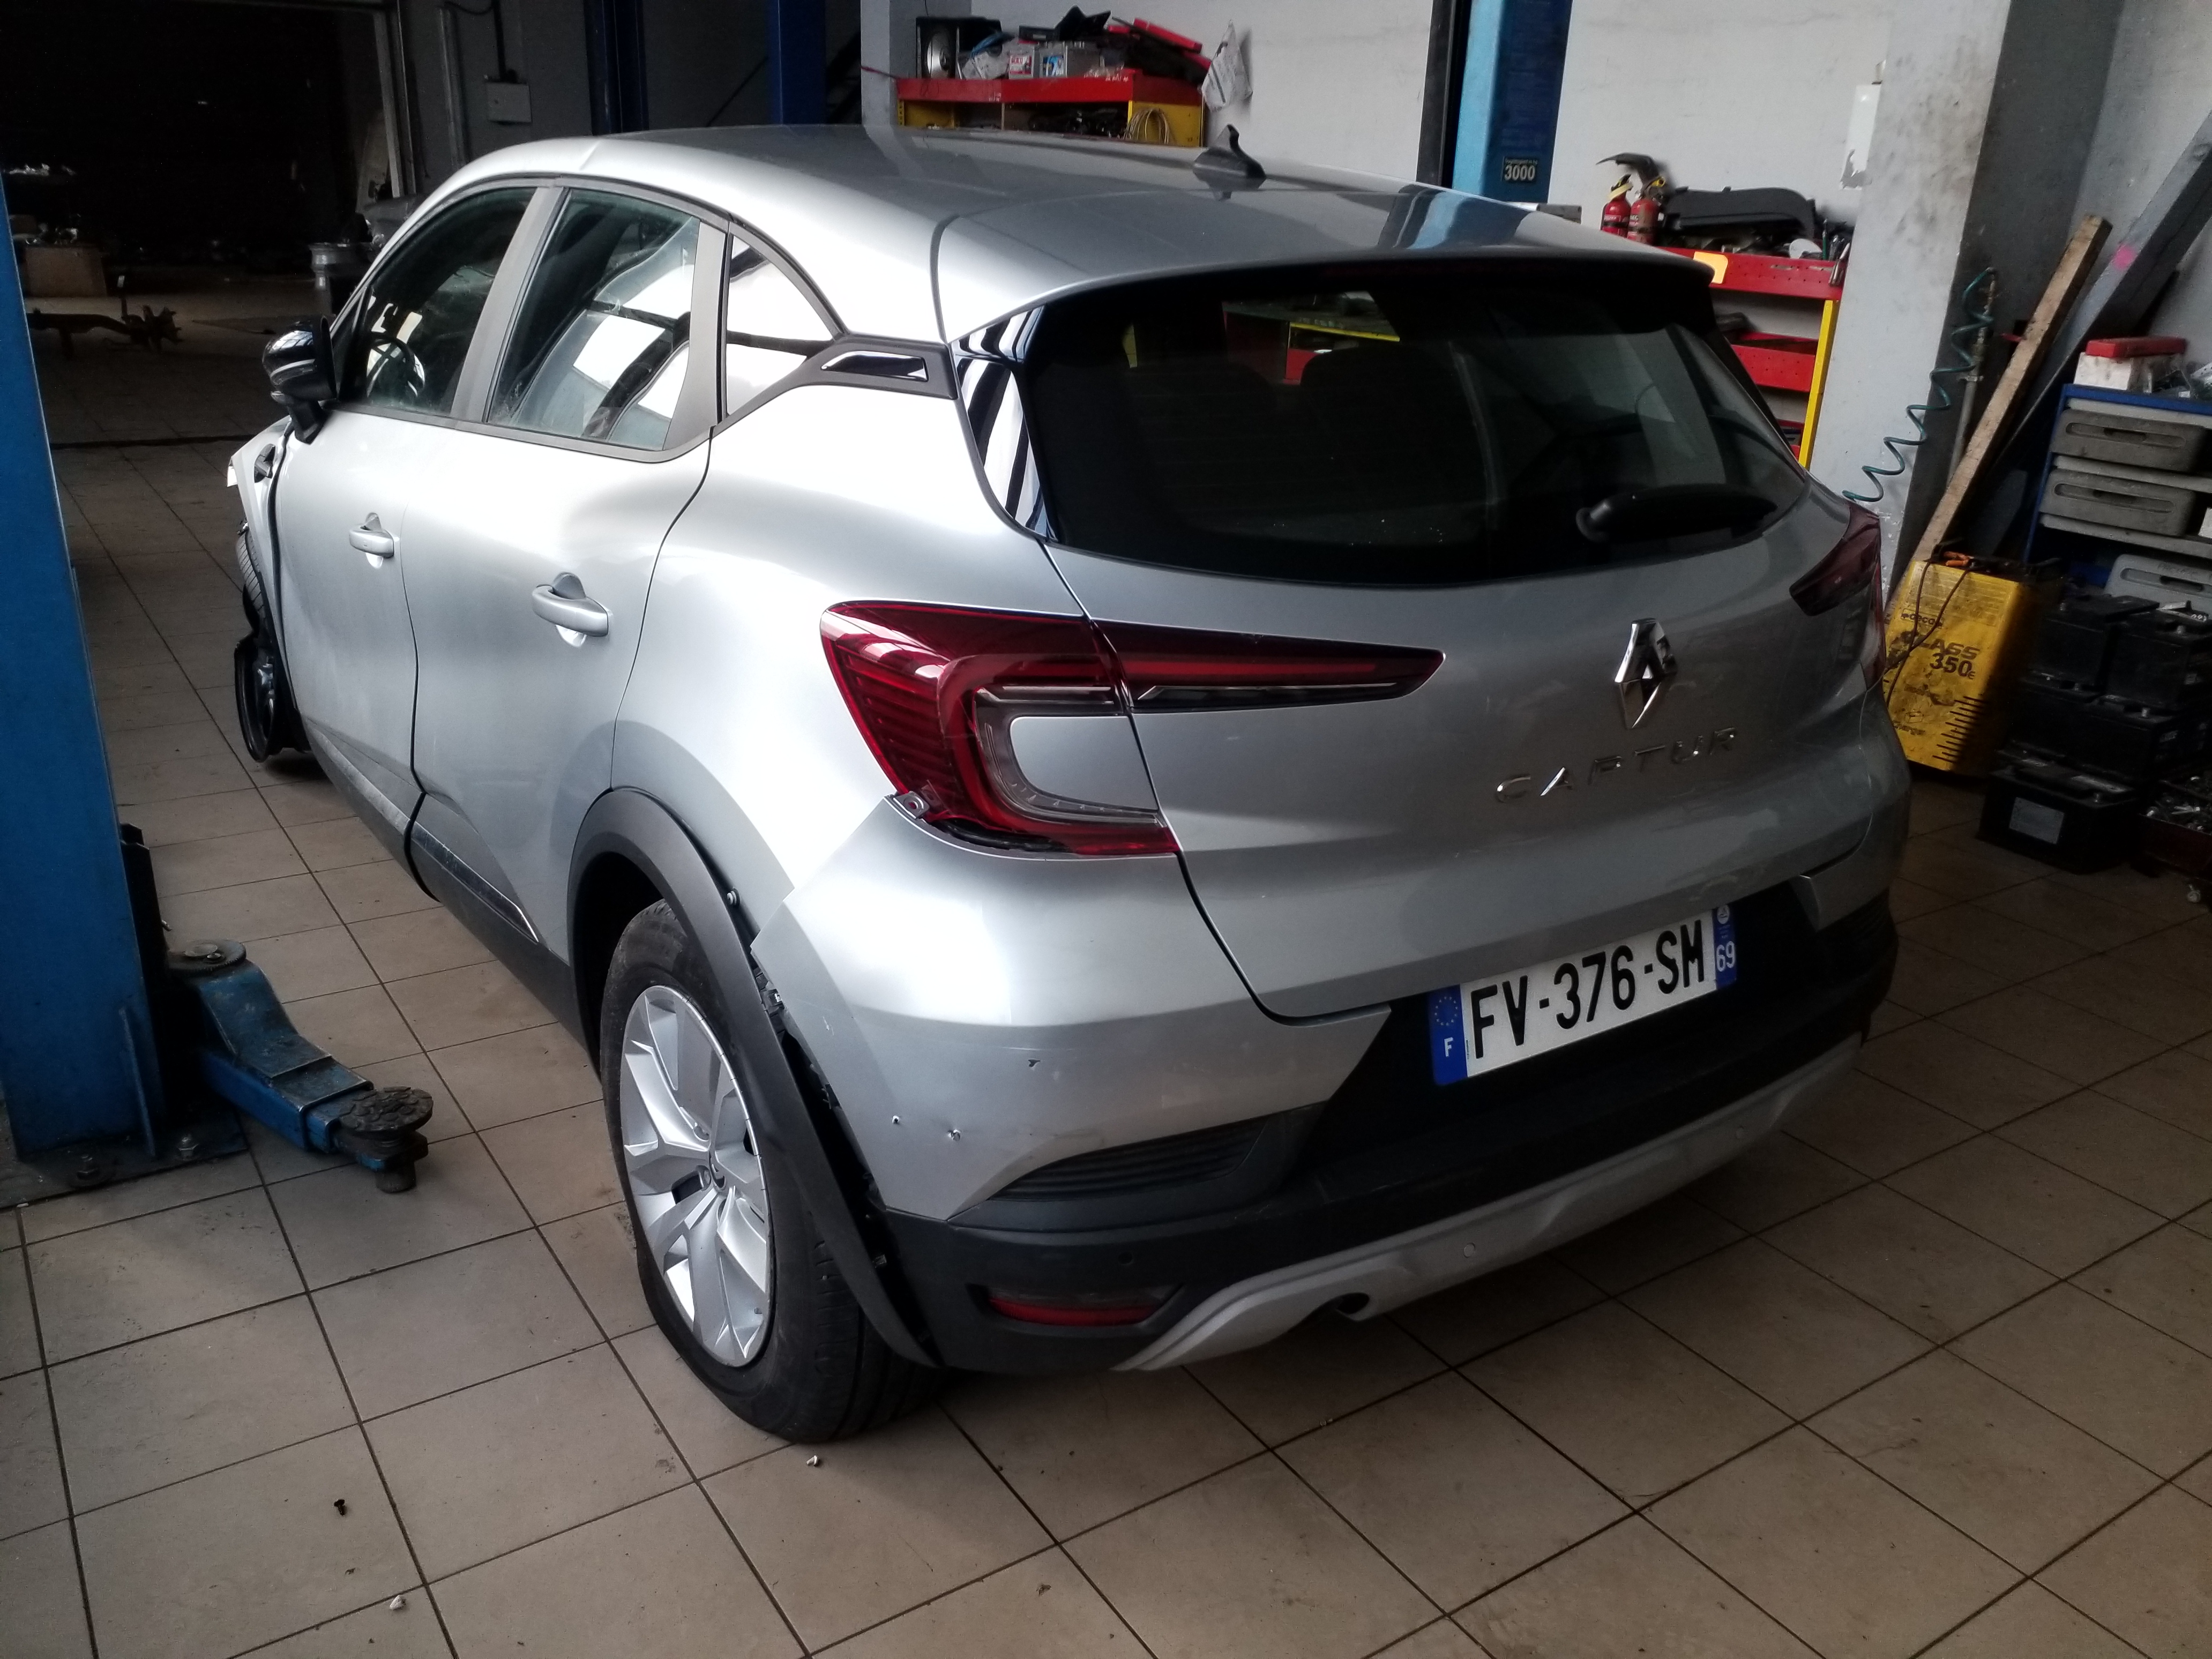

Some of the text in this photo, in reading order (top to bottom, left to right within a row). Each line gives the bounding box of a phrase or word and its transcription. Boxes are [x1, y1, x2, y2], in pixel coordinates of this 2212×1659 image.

[1504, 165, 1536, 181] 3000
[1495, 727, 1736, 803] CAPTUR
[1716, 940, 1736, 972] 69
[1470, 920, 1704, 1059] FV-376-SM
[1444, 1036, 1454, 1058] F
